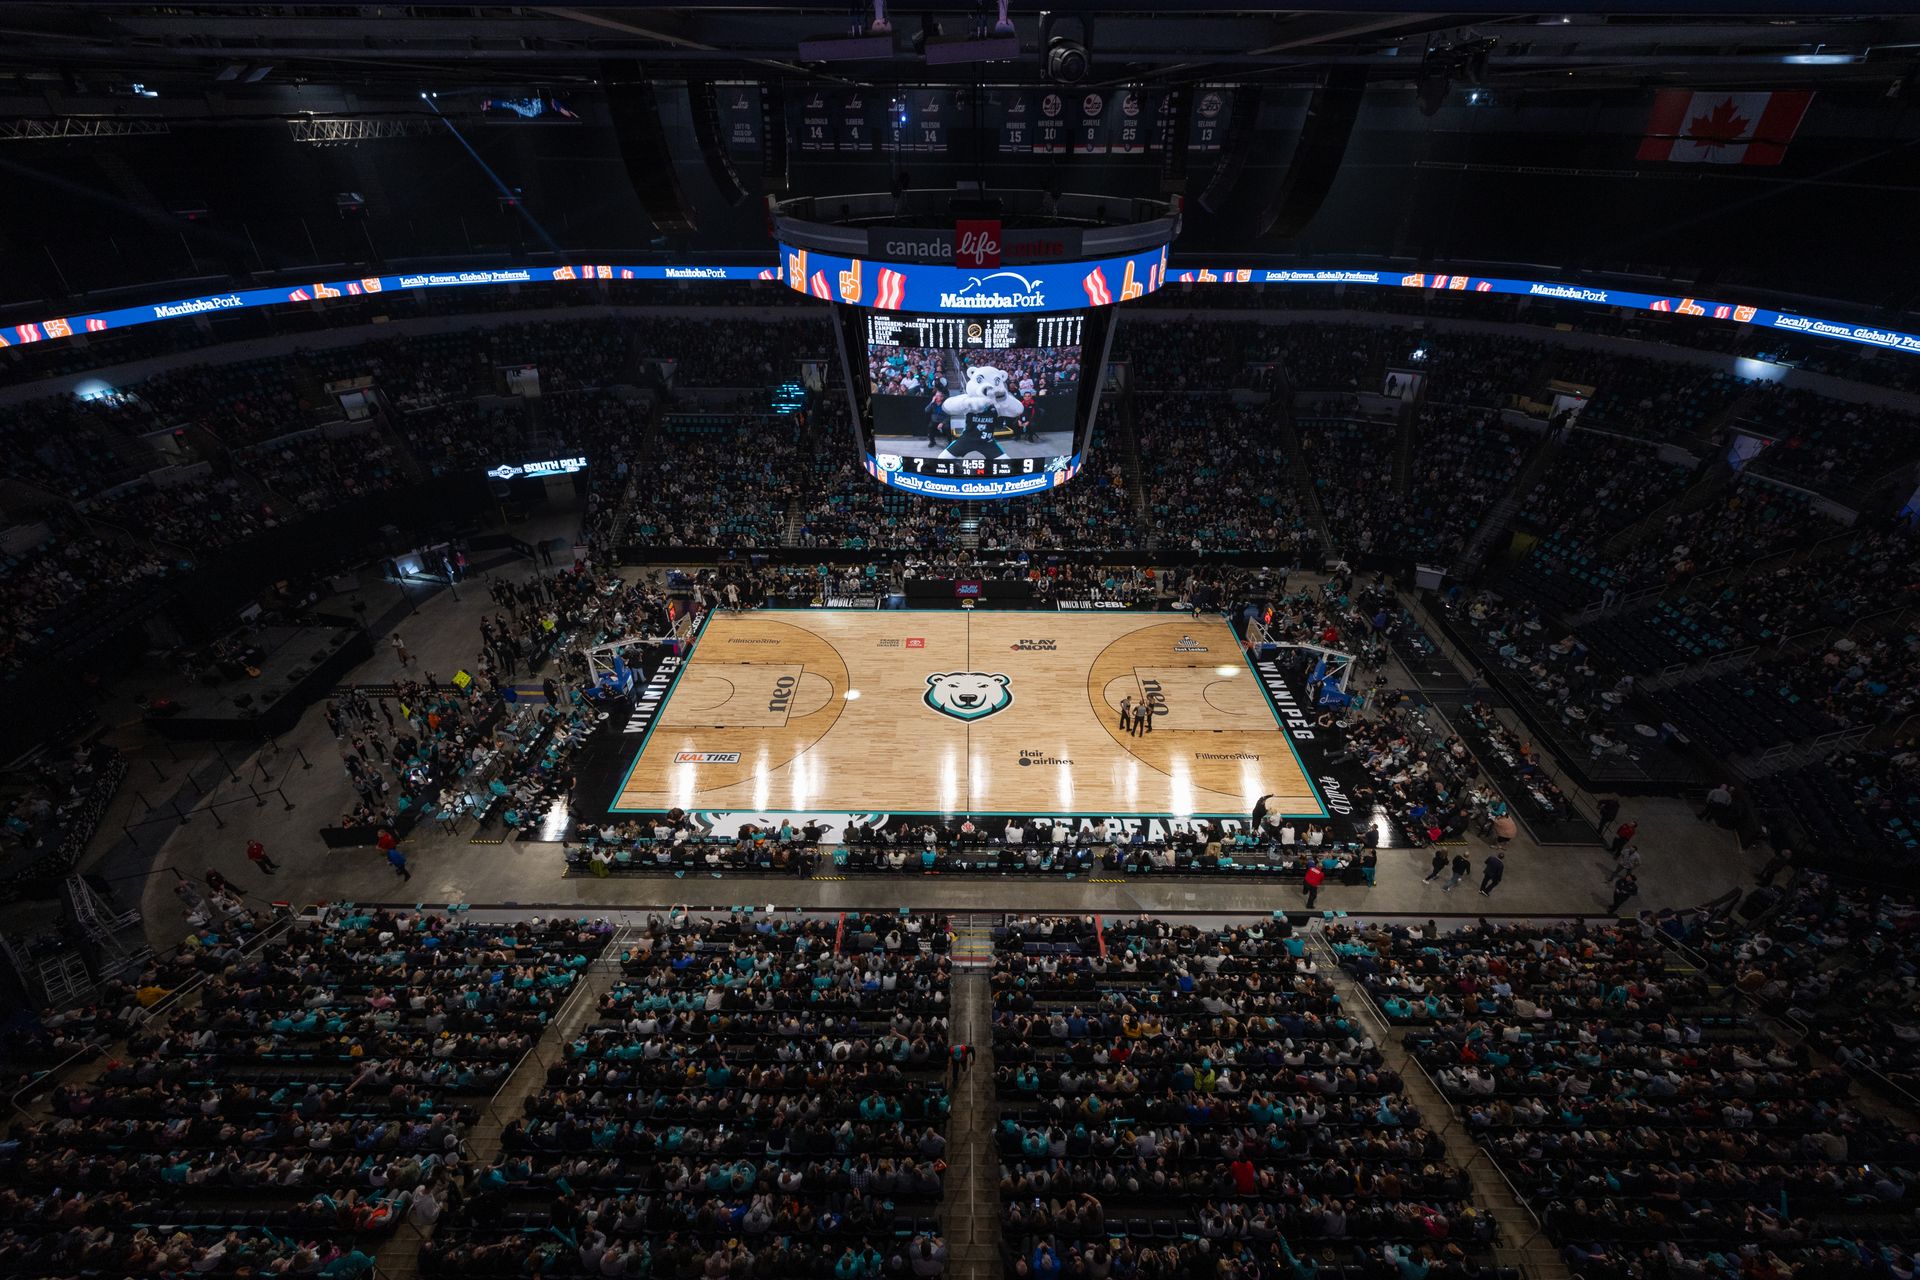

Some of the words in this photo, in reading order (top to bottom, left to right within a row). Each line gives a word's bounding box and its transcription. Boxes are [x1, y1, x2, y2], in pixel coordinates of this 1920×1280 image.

[811, 126, 823, 139] 14
[851, 127, 859, 139] 4
[925, 130, 937, 142] 14
[1009, 131, 1022, 143] 15
[1044, 128, 1056, 140] 10
[1087, 128, 1095, 140] 8
[1122, 129, 1136, 141] 25
[1201, 129, 1213, 141] 13
[886, 237, 952, 257] canada
[956, 231, 1001, 265] life
[1005, 239, 1065, 257] centre
[400, 275, 429, 285] Locally
[429, 275, 460, 283] Grown.
[460, 272, 492, 282] Globally
[492, 270, 530, 280] Preferred.
[665, 268, 726, 278] ManitobaPork
[1266, 271, 1292, 280] Locally
[1291, 271, 1316, 279] Grown.
[1316, 271, 1345, 280] Globally
[1345, 272, 1380, 281] Preferred.
[1529, 284, 1608, 302] ManitobaPork
[939, 291, 1045, 308] ManitobaPork
[153, 295, 244, 318] ManitobaPork
[1775, 315, 1814, 331] Locally
[1812, 322, 1852, 336] Grown.
[1853, 328, 1903, 346] Globally
[967, 336, 983, 344] CEBL
[523, 460, 560, 473] SOUTH
[559, 457, 588, 469] POLE
[913, 458, 924, 473] 7
[962, 459, 985, 469] 4:55
[1022, 458, 1034, 473] 9
[894, 473, 923, 490] Locally
[924, 480, 960, 493] Grown.
[961, 483, 1004, 495] Globally
[1004, 474, 1048, 491] Preferred.
[827, 598, 854, 608] MOBILE
[1060, 601, 1079, 609] WATCH
[1079, 600, 1092, 609] LIVE
[622, 656, 682, 734] WINNIPEG
[768, 676, 795, 713] neo
[1142, 679, 1169, 716] neo
[1257, 661, 1315, 739] WINNIPEG
[679, 753, 704, 761] KAL
[706, 754, 738, 762] TIRE
[1020, 749, 1044, 757] flair
[1195, 752, 1260, 762] FillmoreRiley
